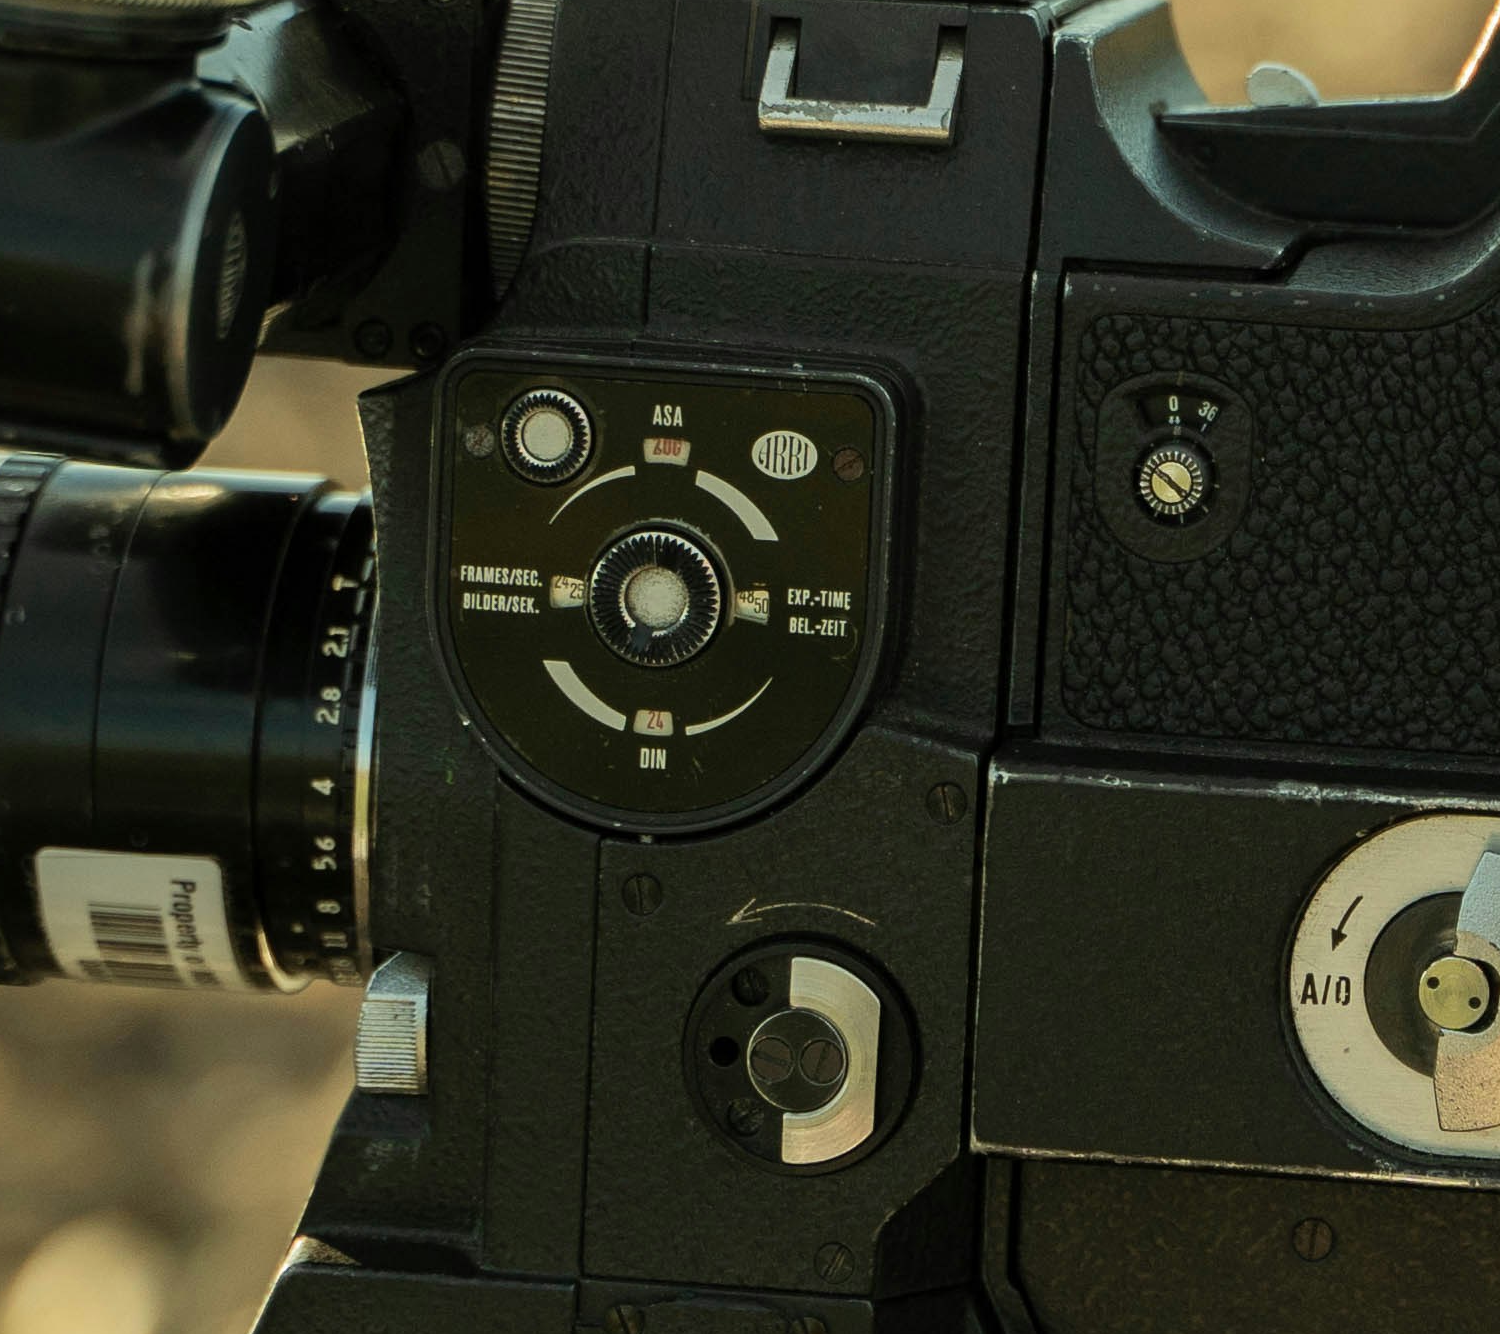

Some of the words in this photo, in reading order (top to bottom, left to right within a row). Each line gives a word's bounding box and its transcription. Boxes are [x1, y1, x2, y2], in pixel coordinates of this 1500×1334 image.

[653, 405, 683, 427] ASA
[1197, 401, 1218, 421] 36
[758, 434, 810, 475] ARRI
[460, 565, 543, 587] FRAMES/SEC.
[462, 592, 539, 614] BILDER/SEK.
[753, 599, 768, 615] 50
[316, 686, 342, 726] 2.8
[647, 710, 664, 730] 24
[640, 748, 667, 769] DIN
[311, 778, 335, 797] 4
[317, 898, 341, 915] 8
